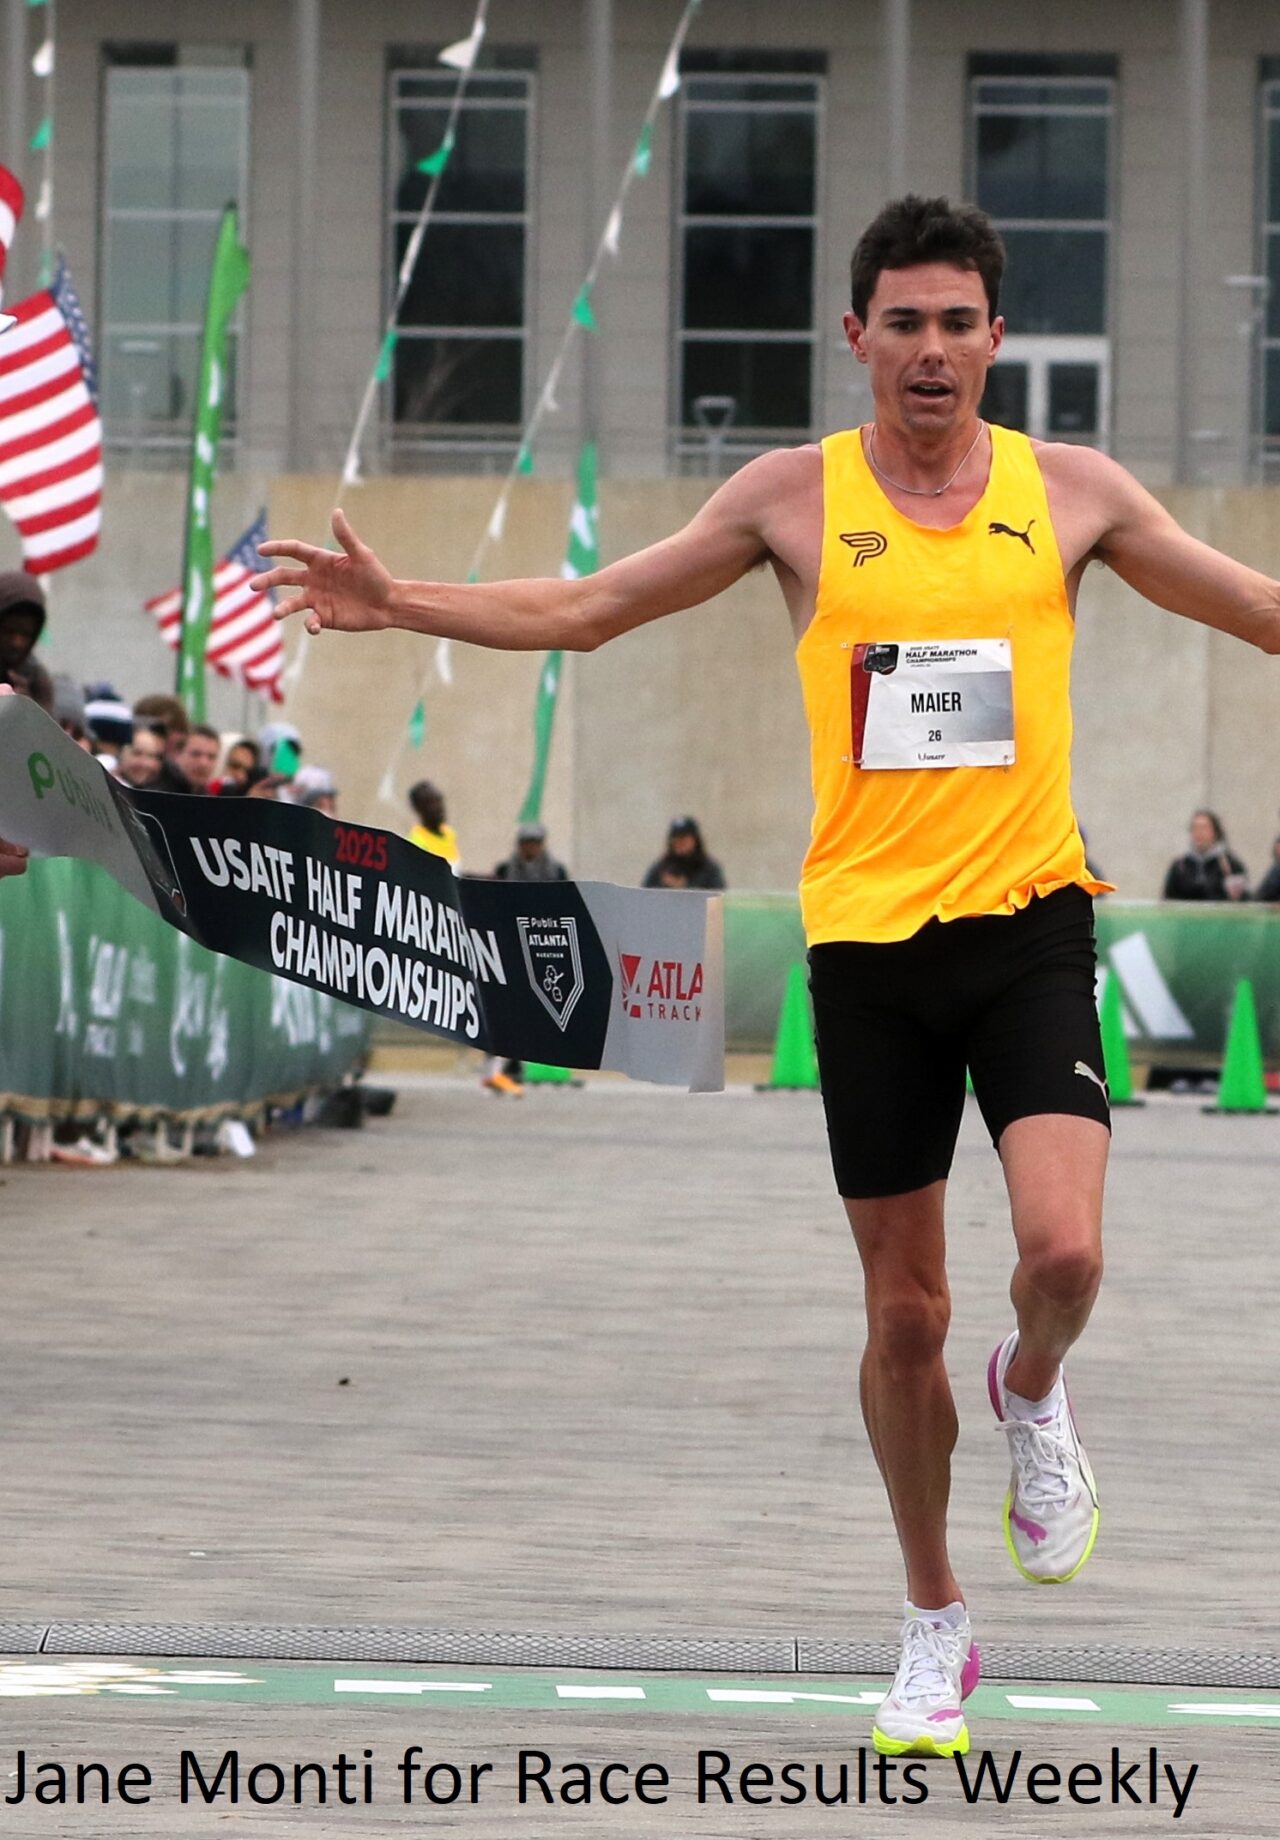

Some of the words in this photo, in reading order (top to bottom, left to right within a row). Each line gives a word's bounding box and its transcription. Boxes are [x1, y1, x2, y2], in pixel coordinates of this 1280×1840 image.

[905, 650, 927, 659] HALF
[930, 649, 978, 658] MARATHON
[911, 691, 962, 714] MAIER
[928, 729, 942, 742] 26
[334, 826, 389, 871] 2025
[189, 836, 295, 903] USATF
[305, 856, 362, 930] HALF
[530, 917, 558, 929] Publix
[528, 934, 569, 947] ATLANTA
[270, 911, 480, 1040] CHAMPIONSHIPS
